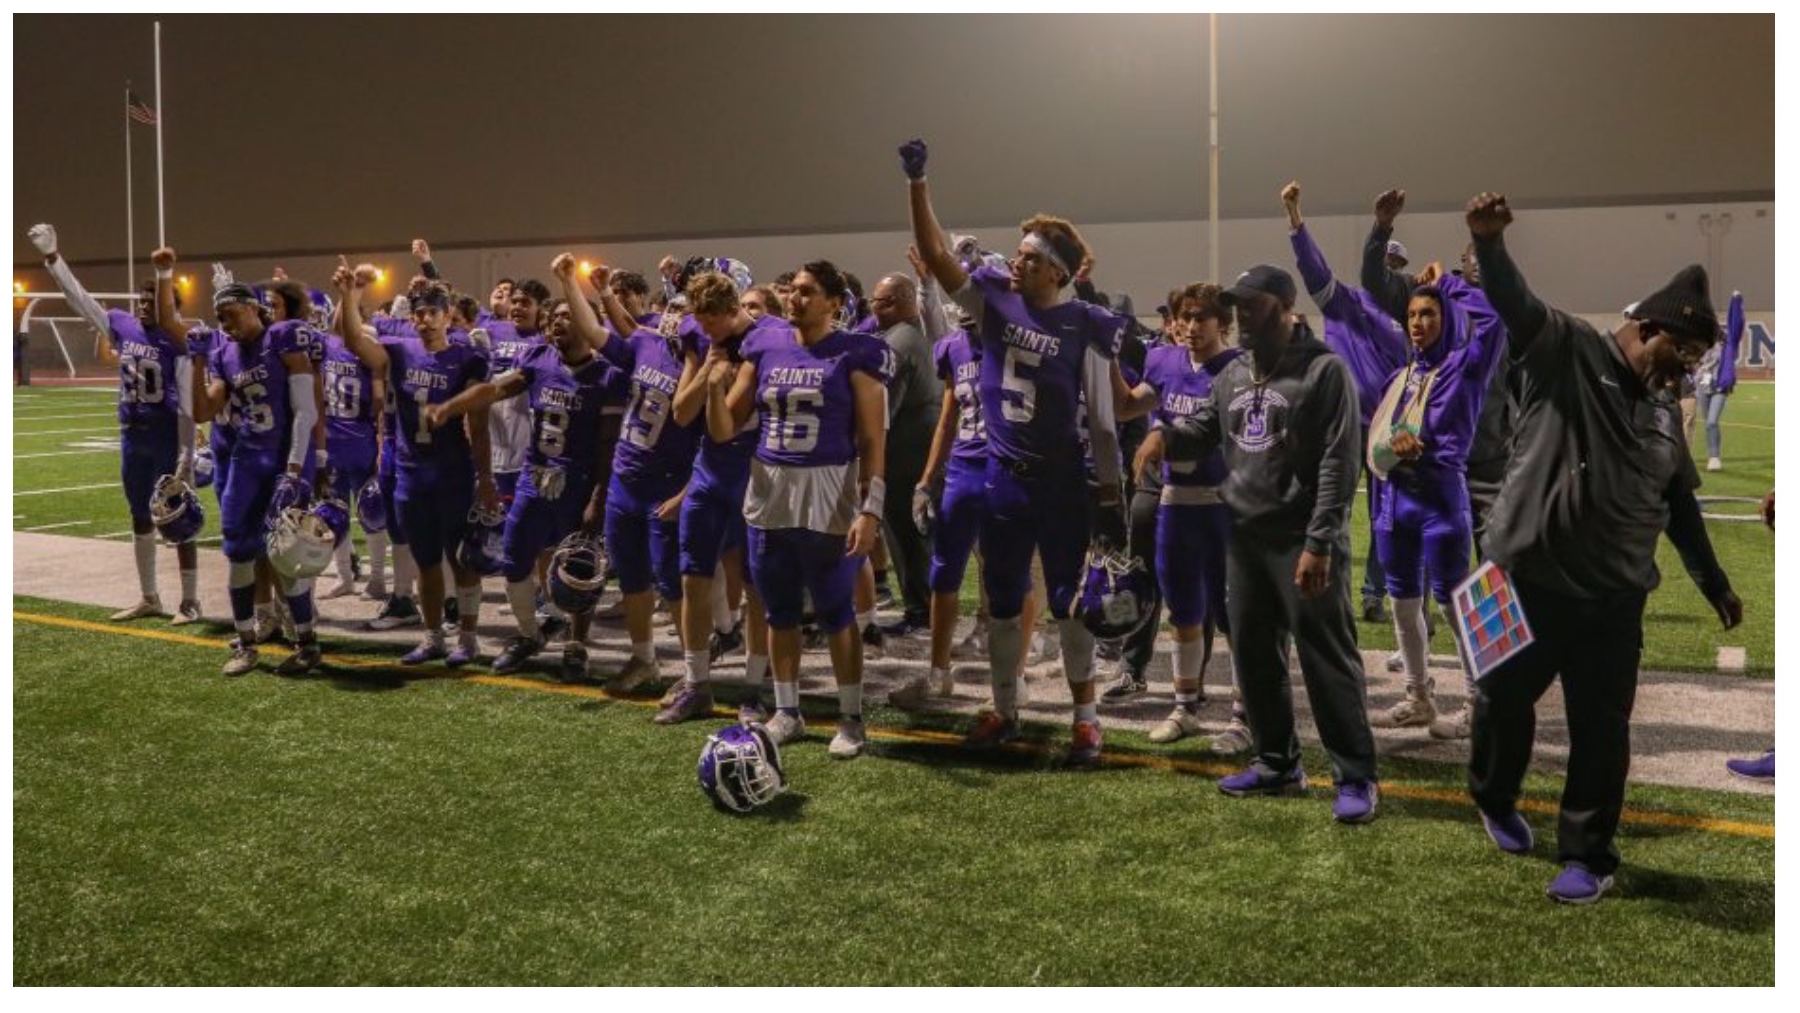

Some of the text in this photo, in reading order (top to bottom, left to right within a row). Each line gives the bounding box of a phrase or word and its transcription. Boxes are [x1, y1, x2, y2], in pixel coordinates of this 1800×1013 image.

[122, 340, 161, 360] SAINTS
[1001, 323, 1062, 357] SAINTS
[405, 368, 449, 390] SAINTS
[631, 364, 679, 395] SAINTS
[767, 367, 825, 387] SAINTS
[1001, 345, 1043, 424] 5
[539, 386, 584, 411] SAINTS
[414, 387, 433, 444] 1
[538, 406, 571, 457] 8
[762, 386, 825, 453] 16
